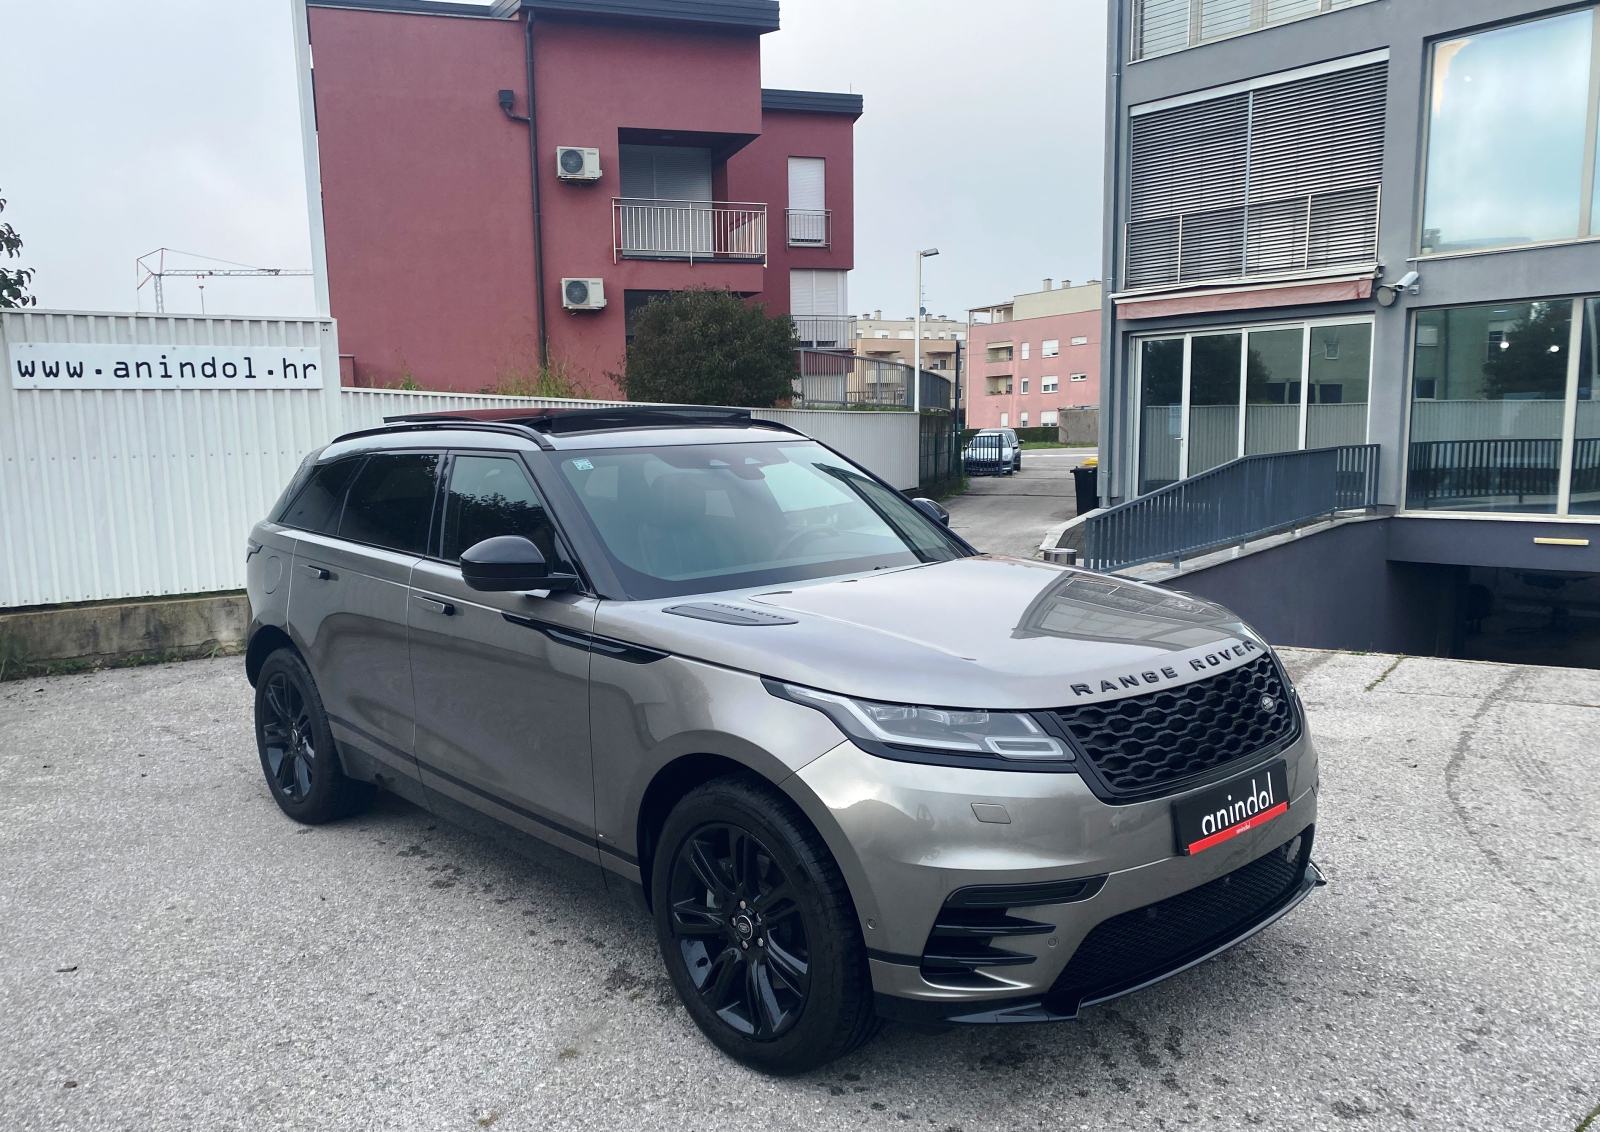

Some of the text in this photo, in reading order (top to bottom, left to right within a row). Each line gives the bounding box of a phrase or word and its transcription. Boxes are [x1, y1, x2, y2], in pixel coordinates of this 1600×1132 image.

[16, 354, 318, 380] www.anindol.hr
[1069, 639, 1256, 697] RANGE ROVER
[1201, 771, 1274, 836] anindol
